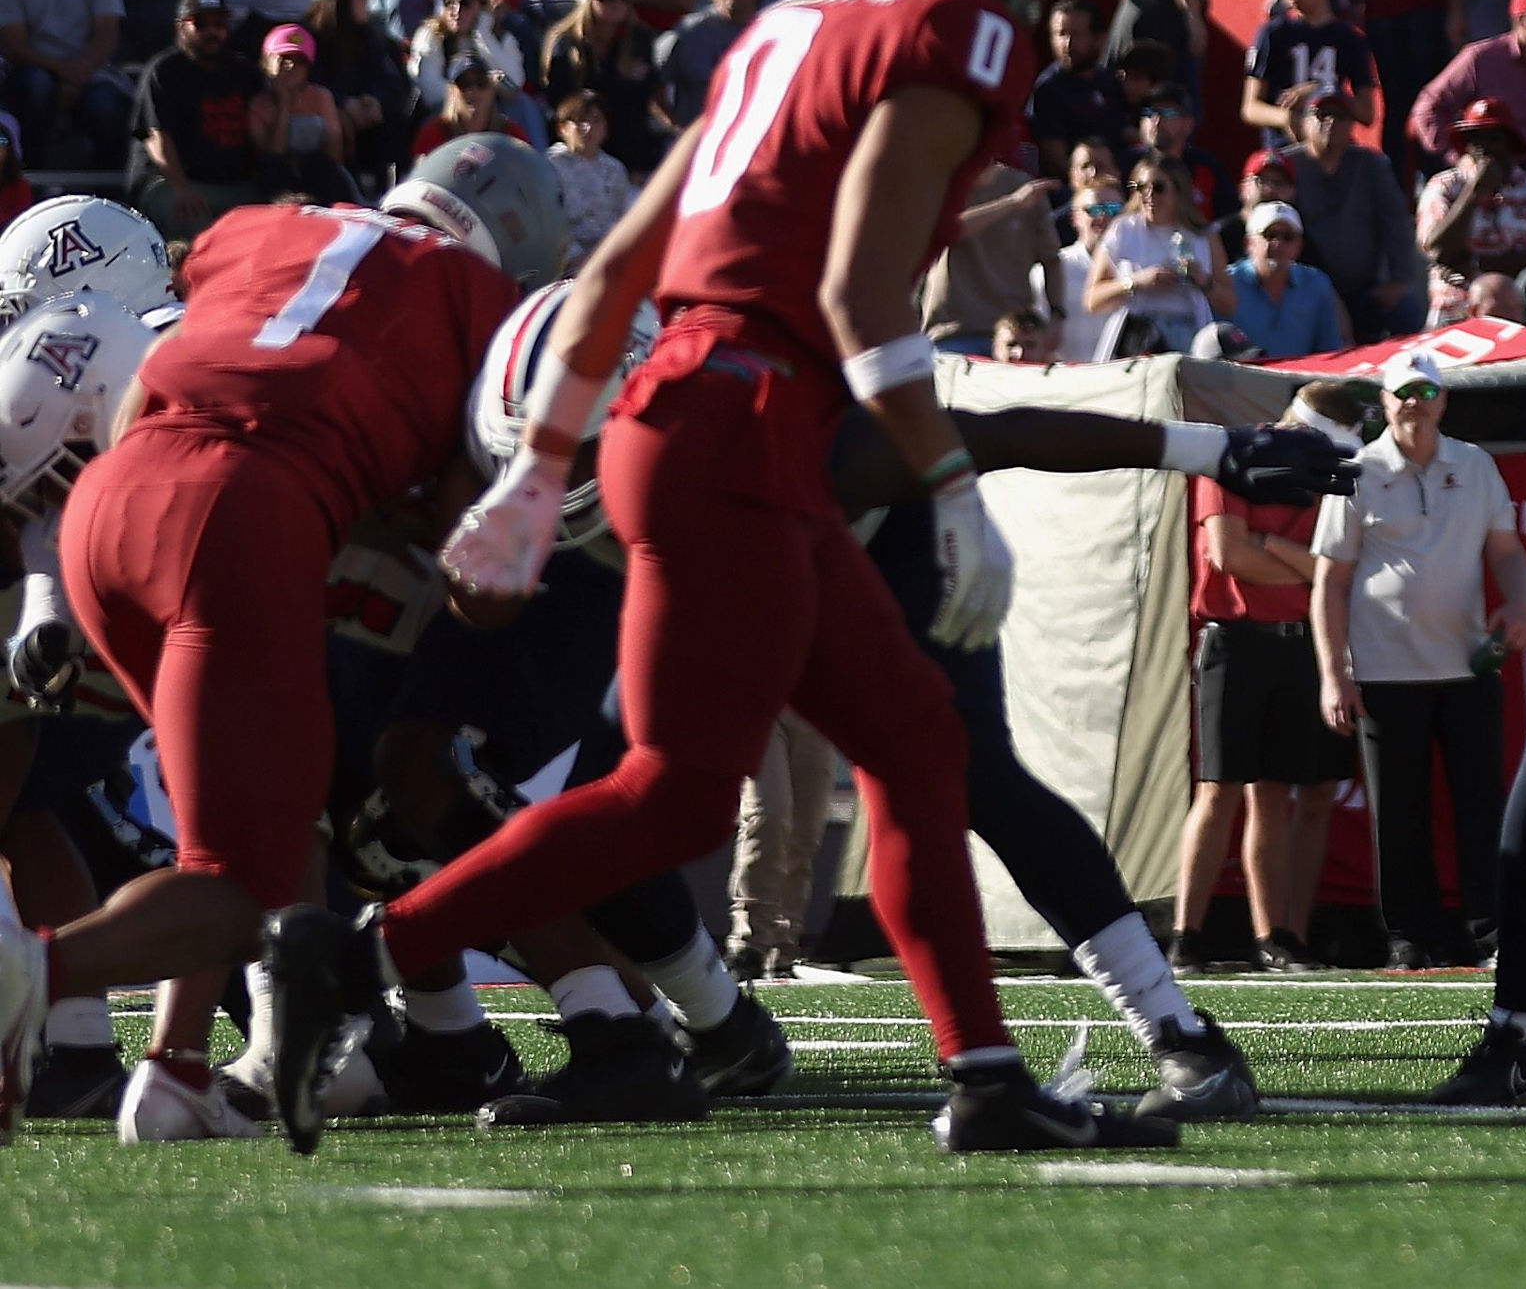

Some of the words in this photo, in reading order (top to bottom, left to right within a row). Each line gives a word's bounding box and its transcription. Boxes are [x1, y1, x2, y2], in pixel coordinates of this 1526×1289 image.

[965, 9, 1015, 89] 0
[677, 5, 824, 219] 0
[47, 220, 106, 278] A
[28, 331, 99, 391] A
